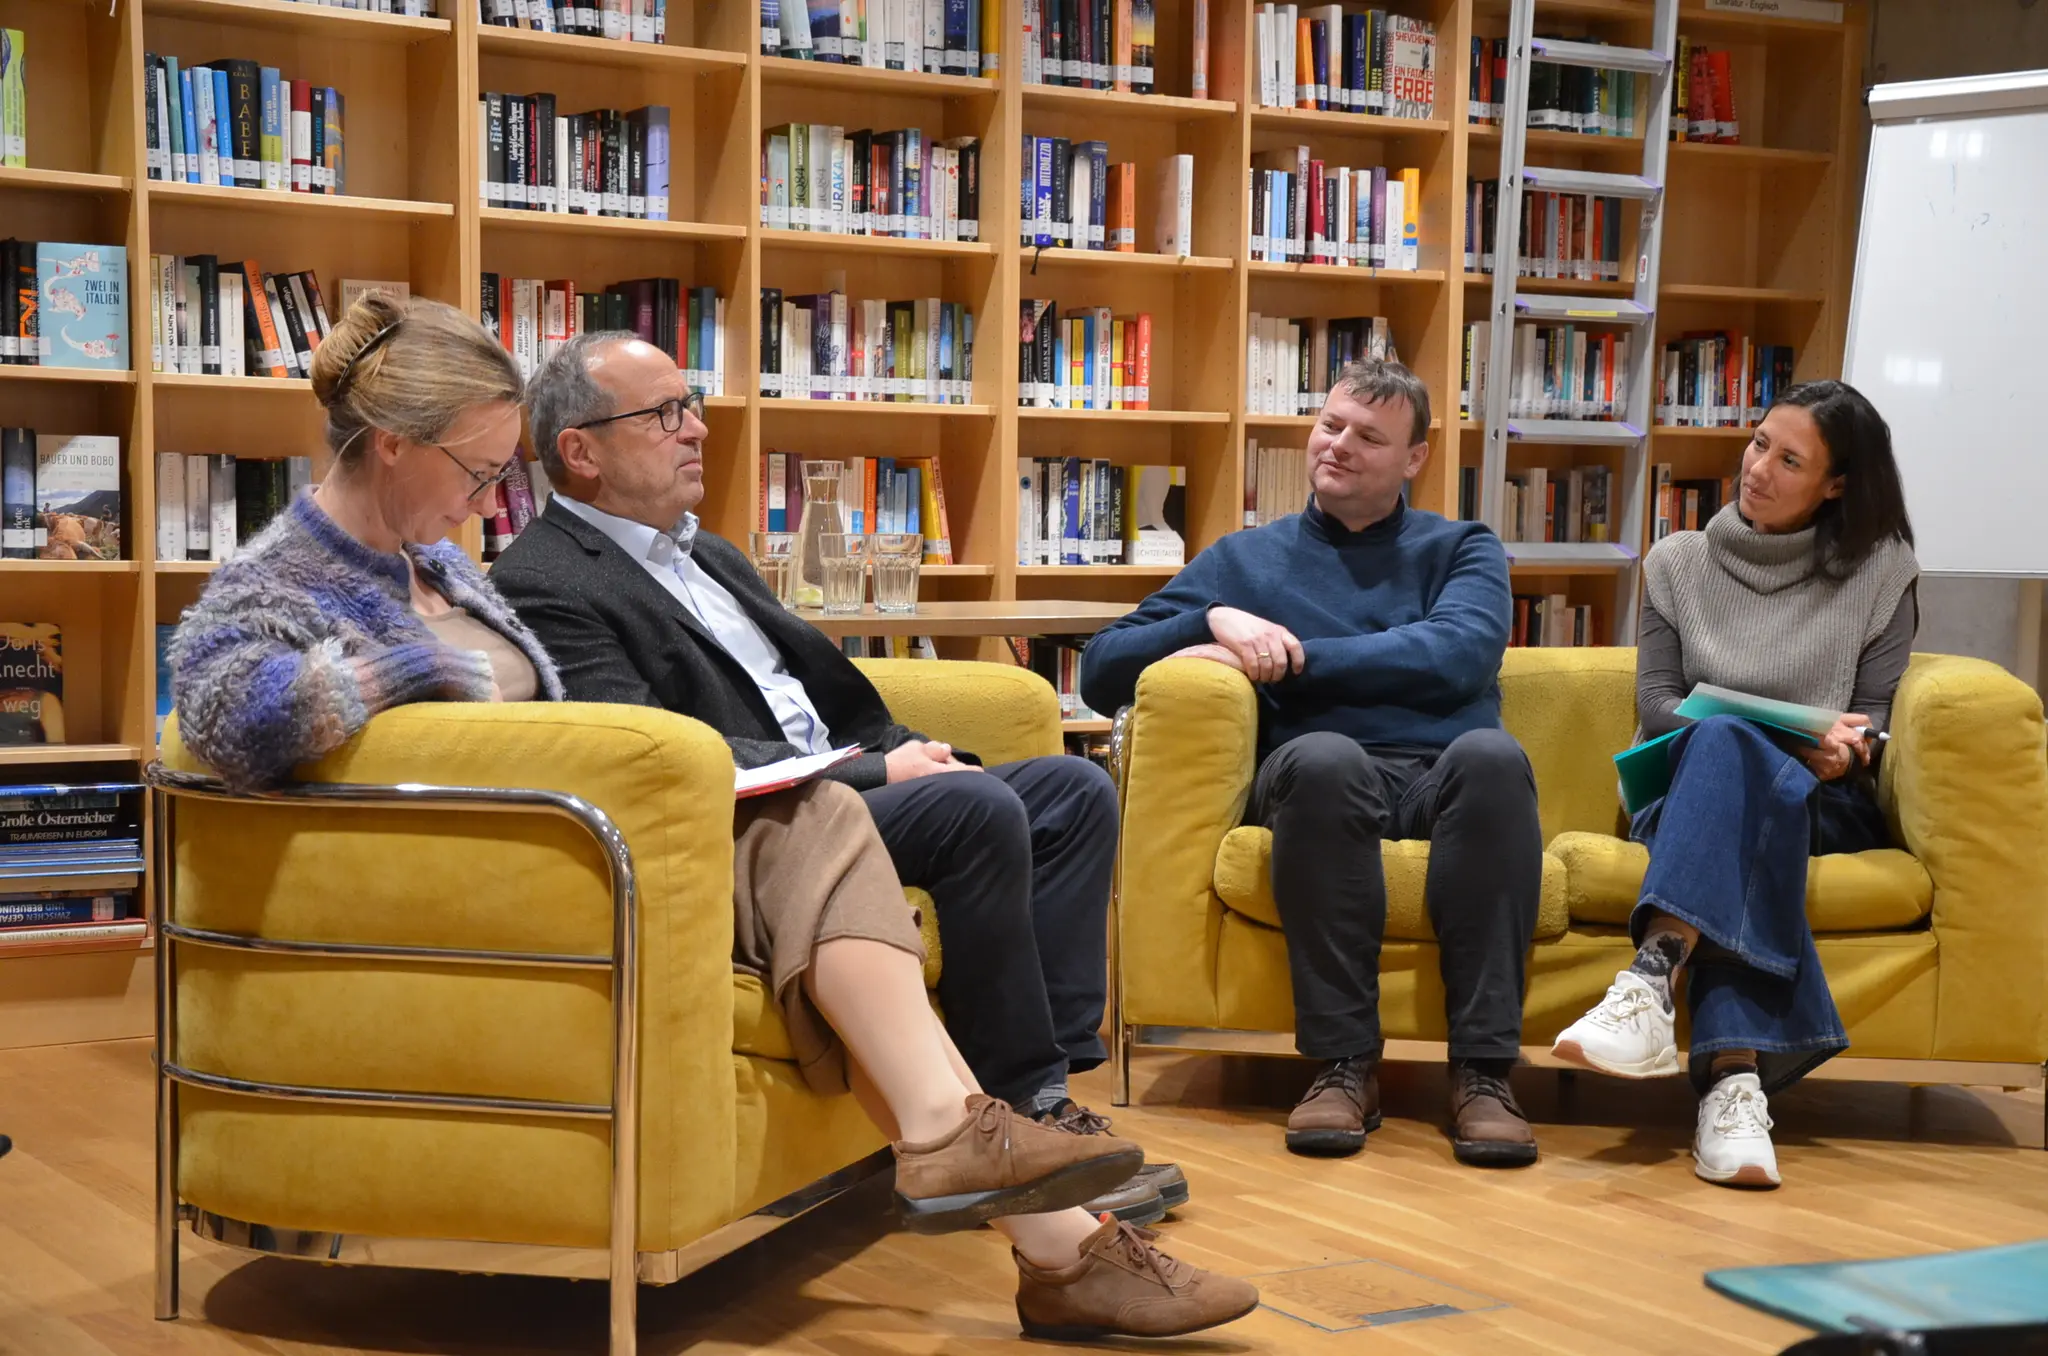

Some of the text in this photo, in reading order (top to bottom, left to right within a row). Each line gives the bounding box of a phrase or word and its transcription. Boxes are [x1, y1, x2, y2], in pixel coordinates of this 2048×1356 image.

[1750, 0, 1779, 12] Englisch
[1394, 65, 1406, 77] EIN
[1394, 76, 1435, 104] ERBE
[1039, 142, 1052, 187] INTERMEZZO
[794, 167, 809, 203] 1Q84
[815, 167, 830, 202] 1Q84
[84, 279, 120, 293] ZWEI IN
[85, 292, 120, 305] ITALIEN
[40, 454, 114, 467] BAUER UND BOBO
[0, 653, 56, 678] necht
[3, 699, 41, 720] weg
[37, 811, 116, 826] Österreicher
[10, 829, 108, 842] TRAUMREISEN IN EUROPA
[45, 903, 65, 912] UND
[26, 911, 72, 921] ZWISCHEN
